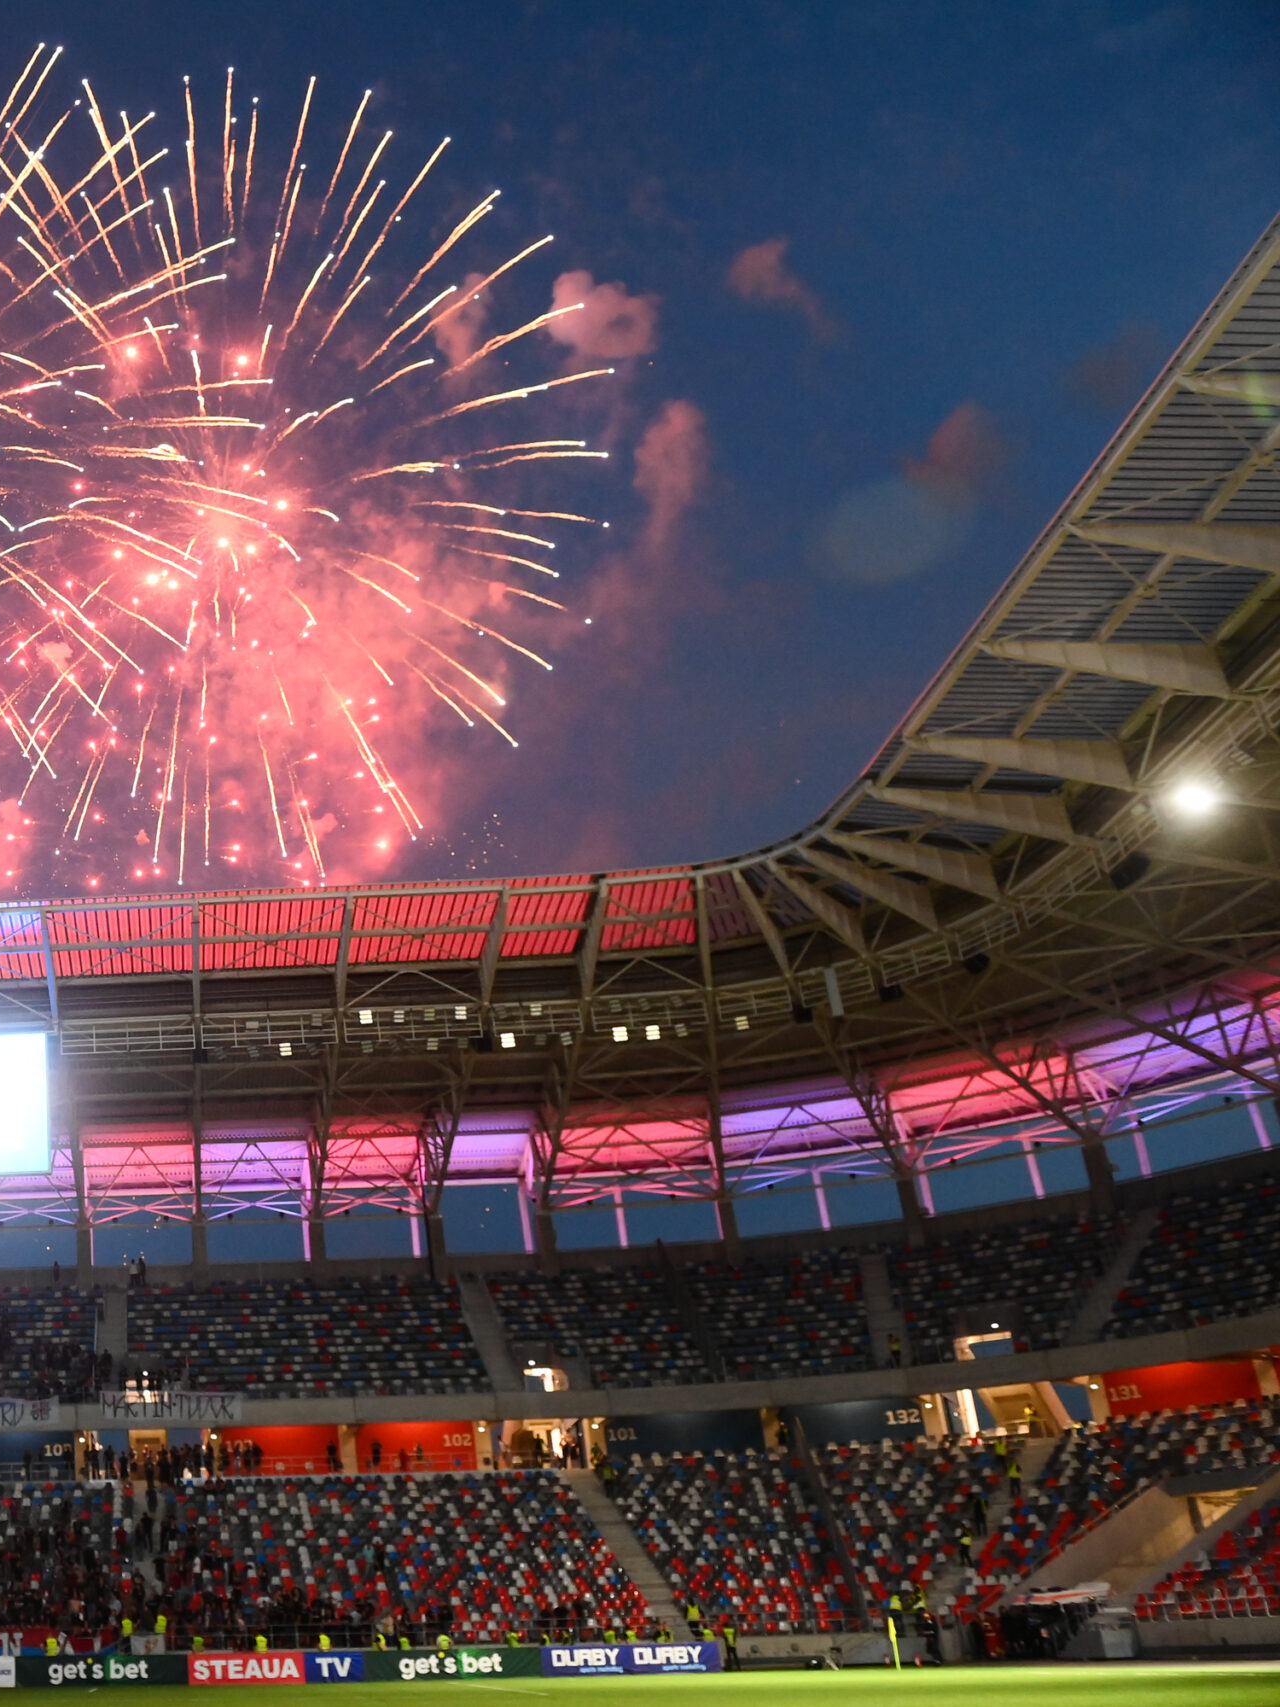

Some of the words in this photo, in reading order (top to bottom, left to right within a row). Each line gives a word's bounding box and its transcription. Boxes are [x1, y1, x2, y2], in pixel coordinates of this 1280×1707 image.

[1110, 1384, 1142, 1402] 131
[885, 1408, 921, 1426] 132
[442, 1433, 473, 1447] 102
[608, 1427, 638, 1442] 101
[109, 1658, 149, 1680] bet
[193, 1657, 300, 1680] STEAUA
[315, 1656, 352, 1678] TV
[461, 1652, 503, 1674] bet
